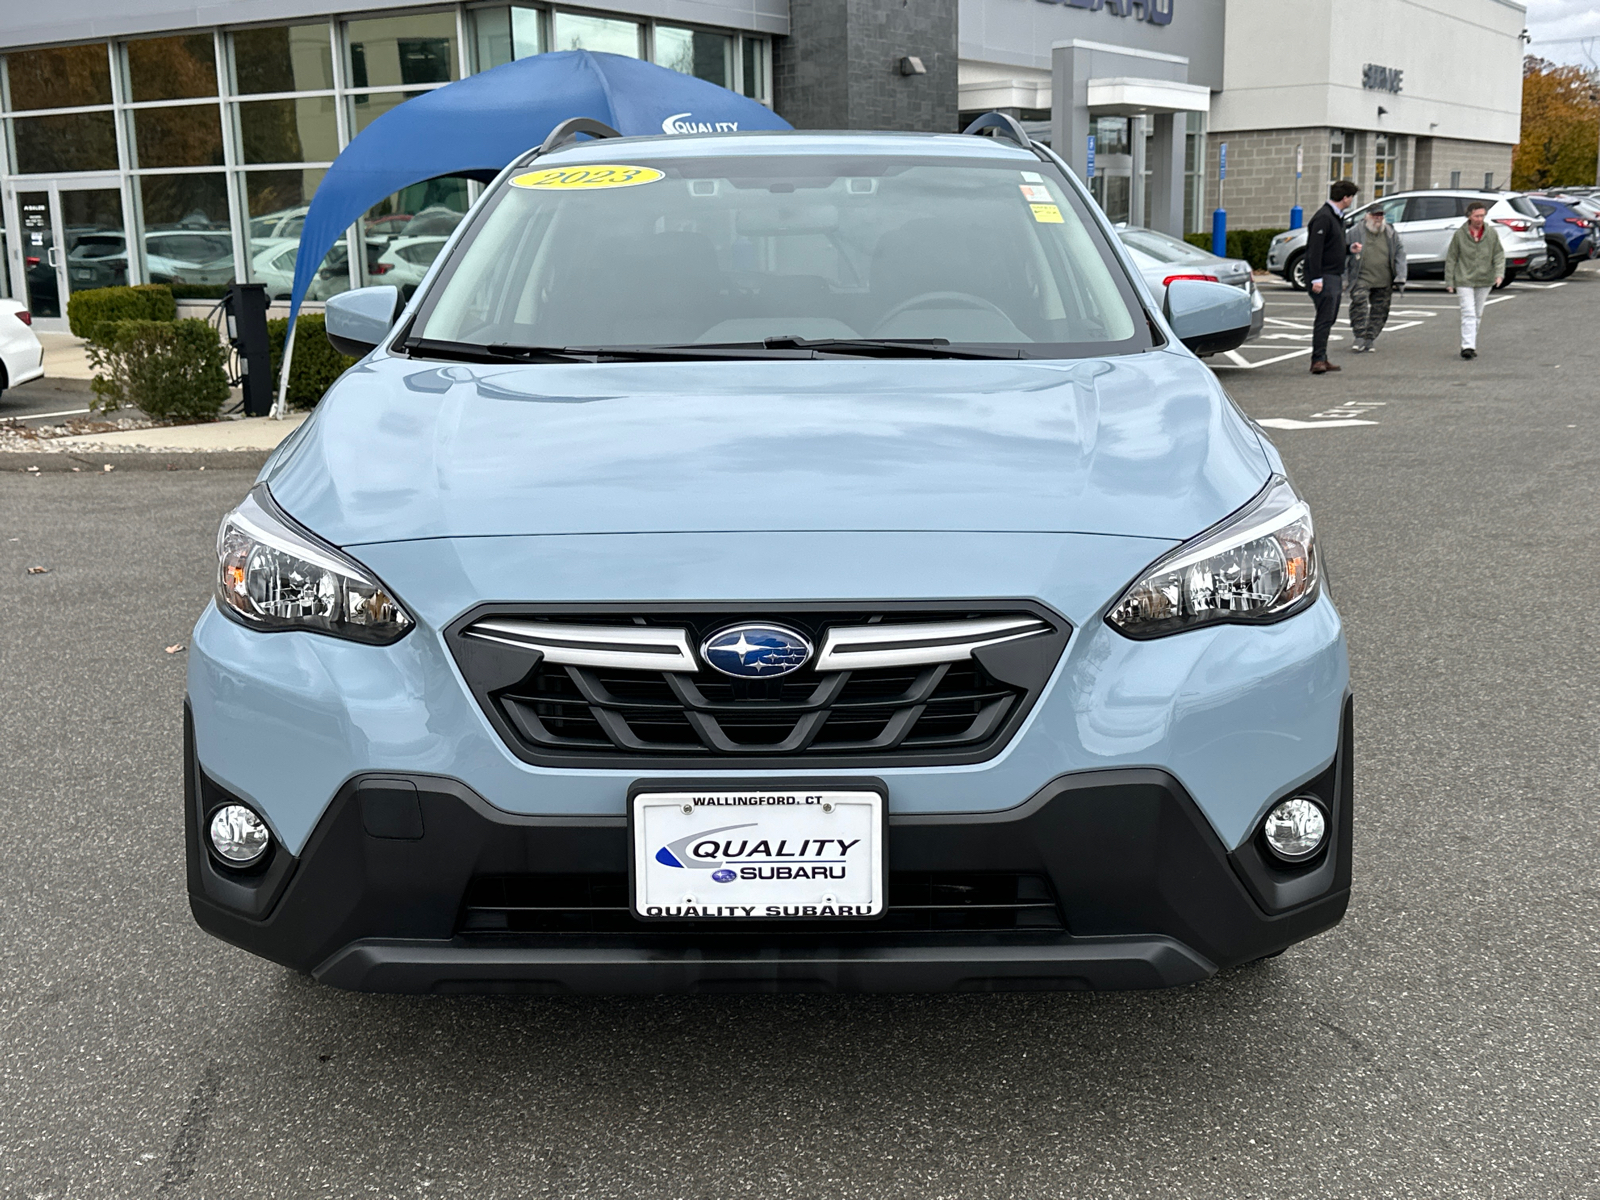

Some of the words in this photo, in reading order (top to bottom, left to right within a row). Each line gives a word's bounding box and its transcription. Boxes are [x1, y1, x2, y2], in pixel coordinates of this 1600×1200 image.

[674, 121, 738, 134] QUALITY
[533, 170, 641, 185] 2023
[805, 796, 822, 805] CT
[692, 839, 860, 858] QUALITY
[740, 866, 846, 880] SUBARU
[646, 906, 756, 917] QUALITY
[765, 905, 872, 916] SUBARU
